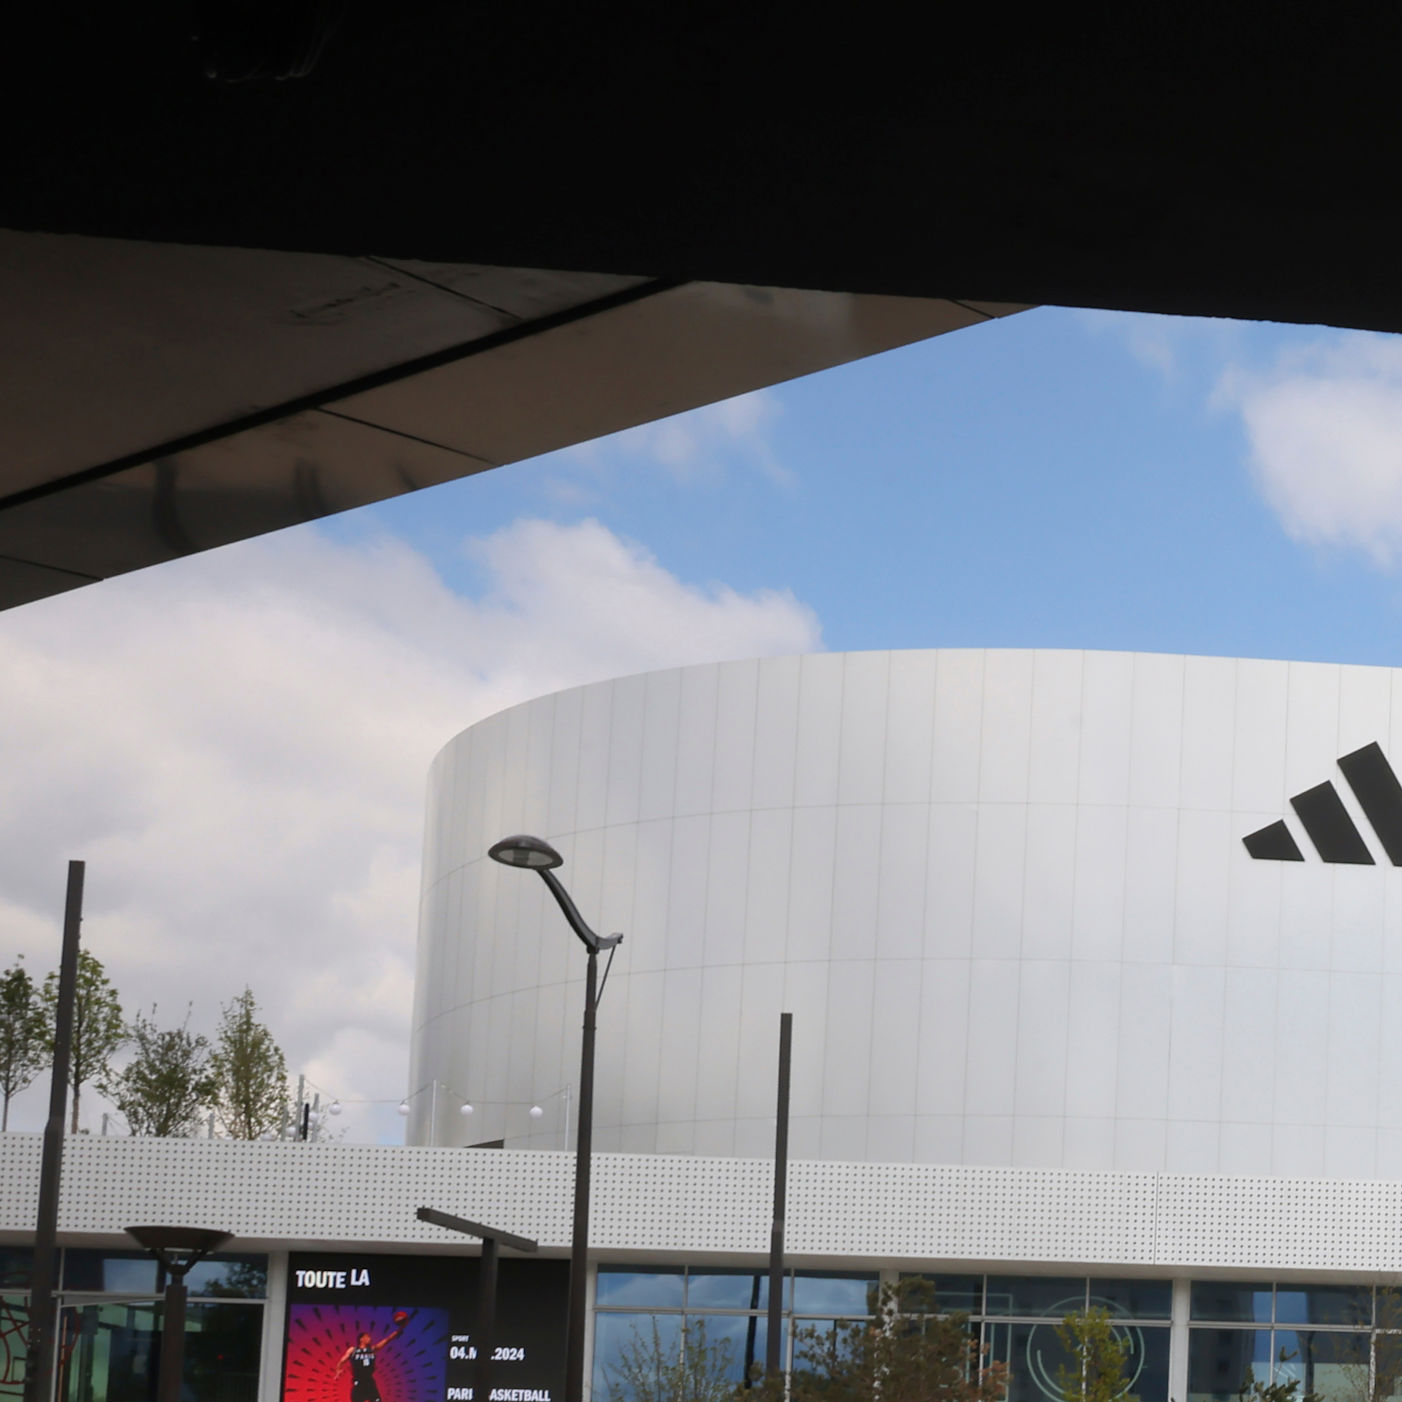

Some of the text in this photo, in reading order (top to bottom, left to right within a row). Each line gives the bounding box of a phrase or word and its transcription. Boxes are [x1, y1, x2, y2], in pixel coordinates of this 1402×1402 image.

[295, 1268, 371, 1289] TOUTE LA
[447, 1387, 552, 1402] PARI ASKETBALL
